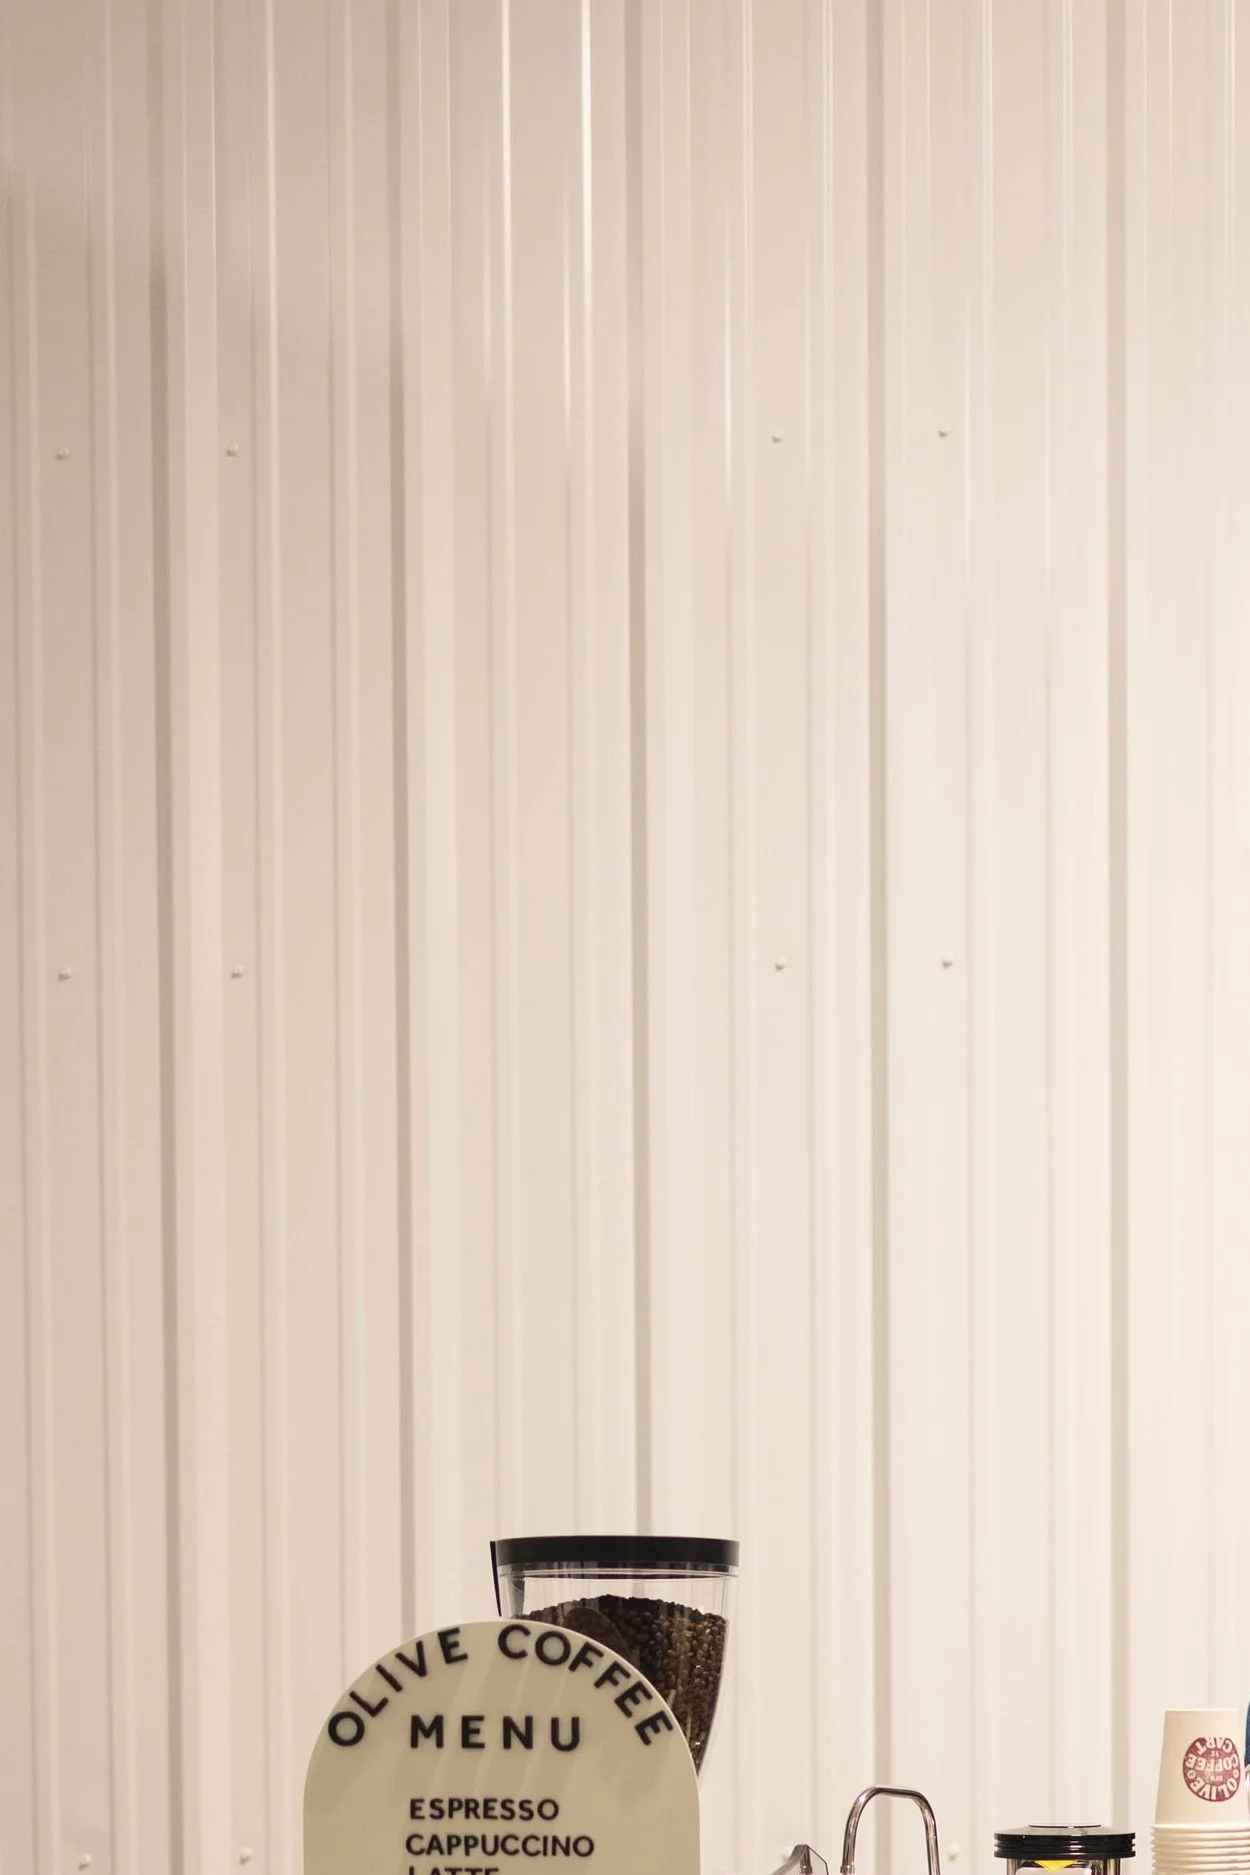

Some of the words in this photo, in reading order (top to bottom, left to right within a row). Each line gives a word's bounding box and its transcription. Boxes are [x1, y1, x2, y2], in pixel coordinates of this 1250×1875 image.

[327, 1627, 469, 1747] OLIVE
[497, 1623, 675, 1750] COFFEE
[410, 1714, 581, 1753] MENU
[1194, 1736, 1233, 1755] CART
[1185, 1753, 1239, 1772] COFFEE
[1189, 1777, 1238, 1800] OLIVE
[409, 1797, 560, 1822] ESPRESSO
[405, 1833, 595, 1858] CAPPUCCINO
